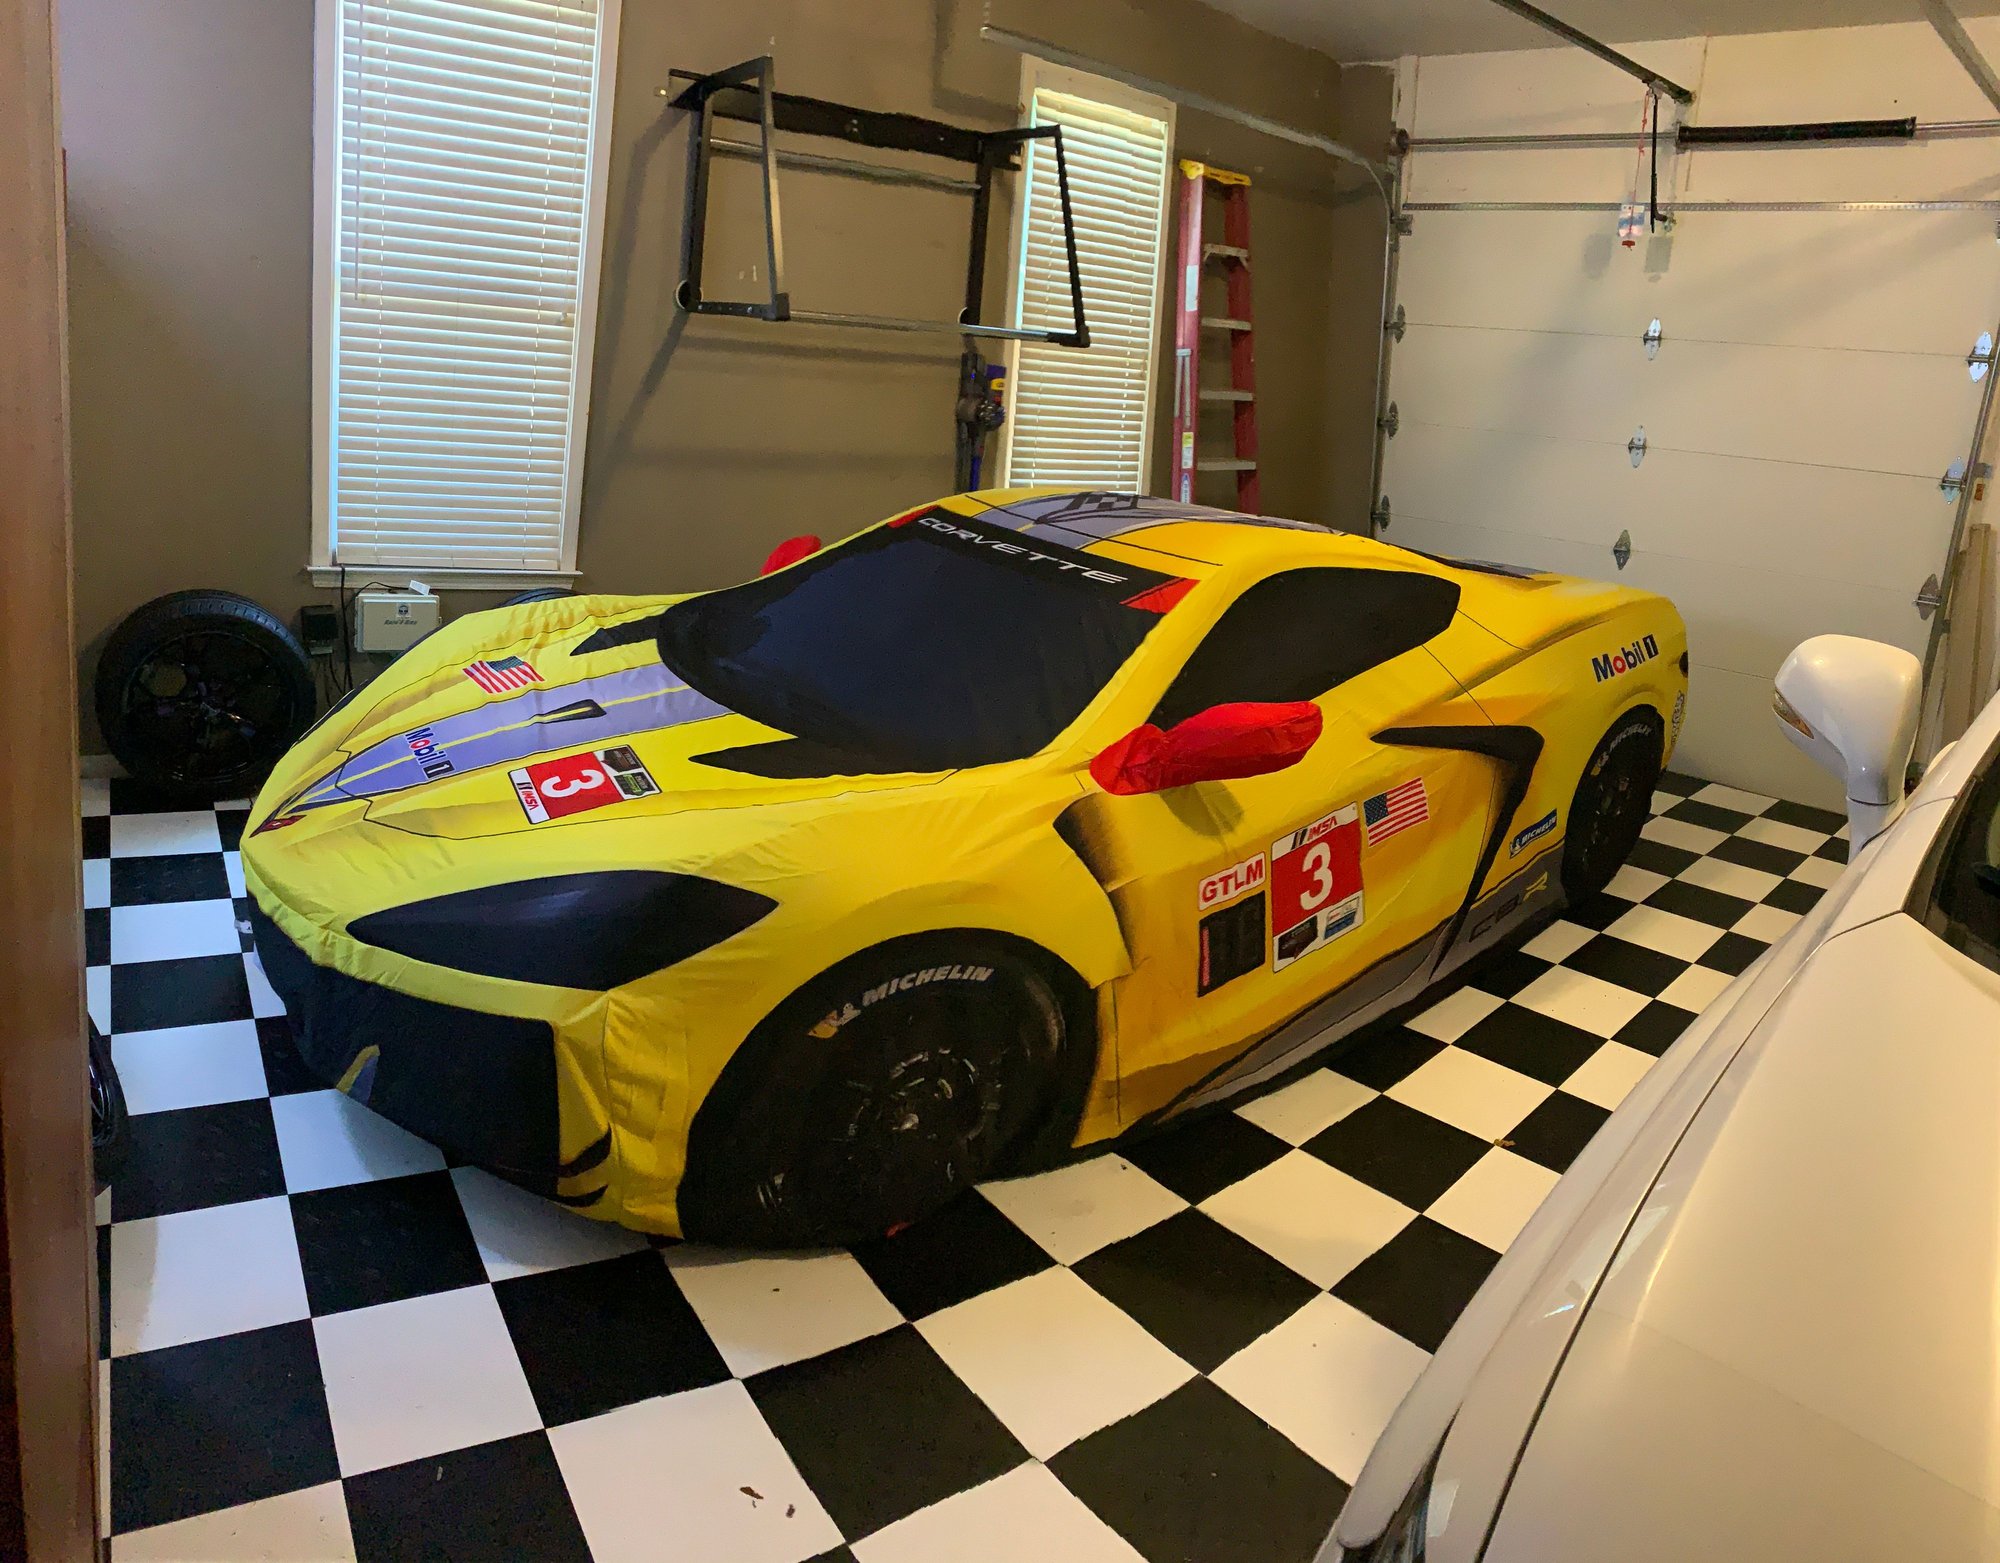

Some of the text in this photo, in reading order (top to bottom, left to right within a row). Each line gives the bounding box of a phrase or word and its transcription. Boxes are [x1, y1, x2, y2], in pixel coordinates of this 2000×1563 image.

[918, 517, 1129, 584] CORVETTE
[1591, 641, 1646, 683] Mobil
[405, 727, 447, 764] Mobil
[521, 790, 540, 811] IMSA
[540, 769, 606, 799] 3
[1307, 816, 1338, 842] IMSA
[1521, 815, 1557, 844] MICHELIN
[1201, 858, 1264, 903] GTLM
[1300, 842, 1333, 911] 3
[861, 964, 995, 1007] MICHELIN
